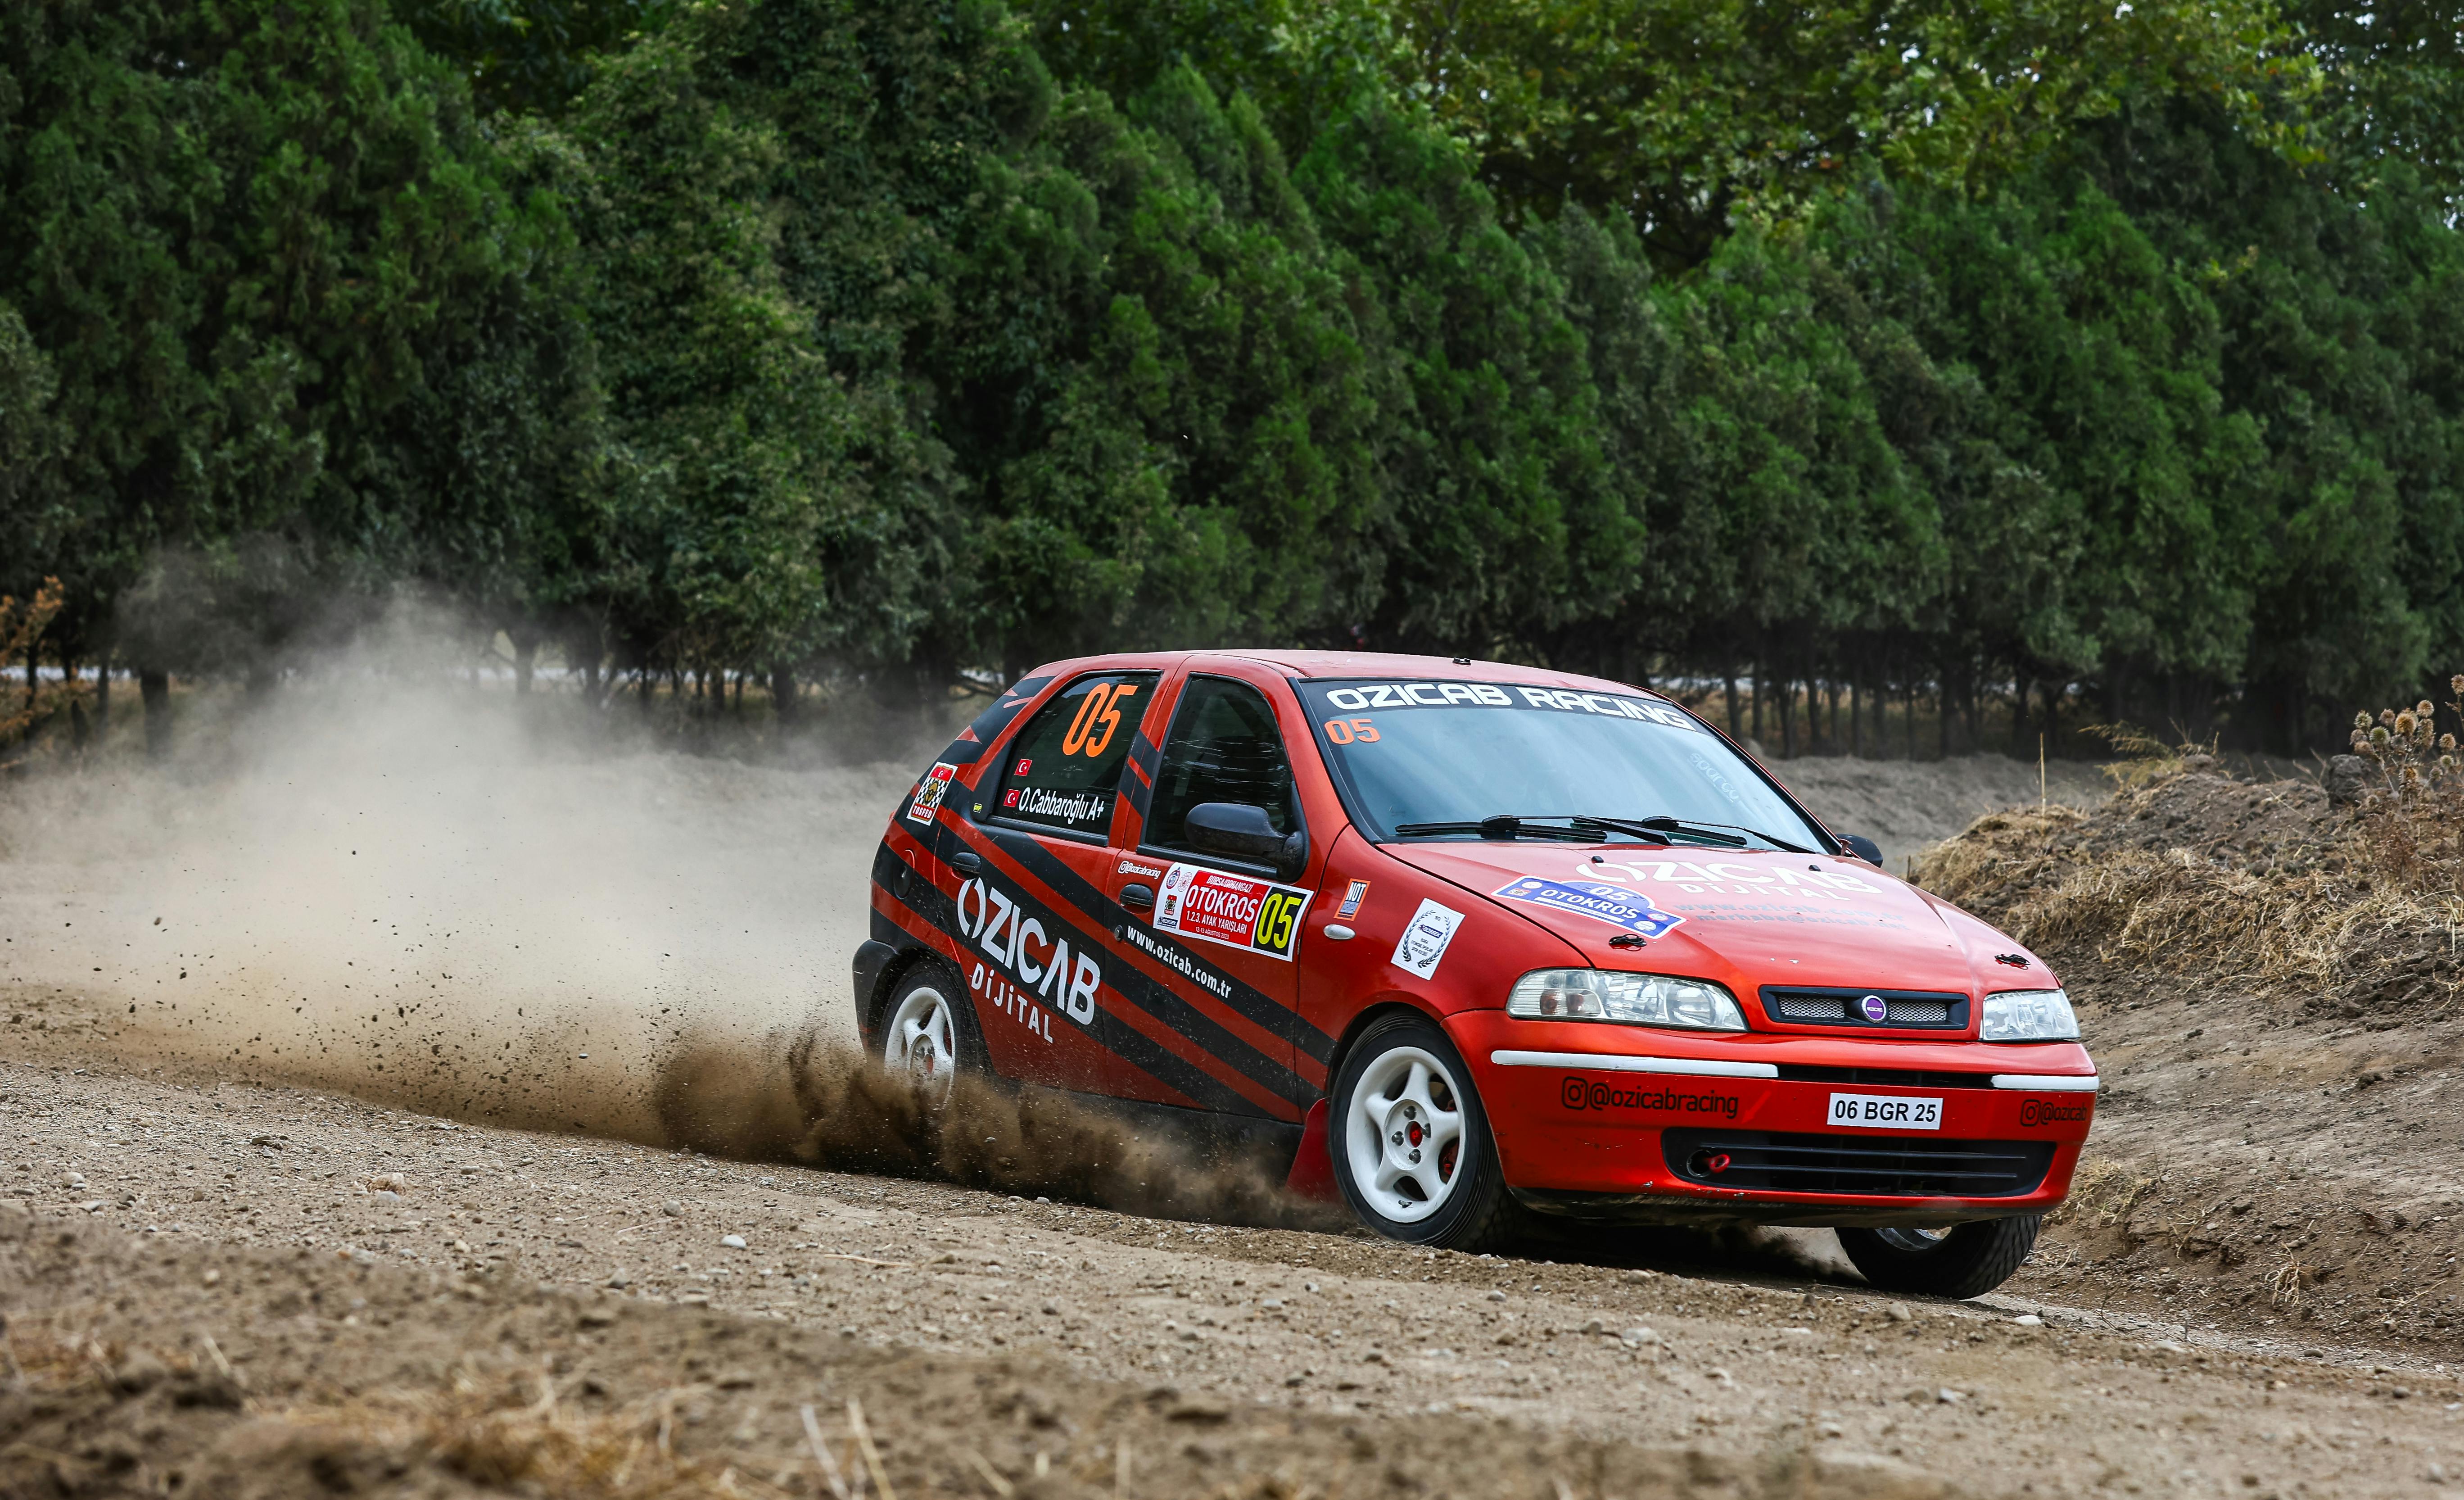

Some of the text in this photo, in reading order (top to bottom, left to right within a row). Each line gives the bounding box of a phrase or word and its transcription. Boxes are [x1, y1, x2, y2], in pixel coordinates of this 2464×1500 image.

[1062, 683, 1138, 757] 05
[1326, 684, 1697, 731] OZICAB RACING
[1325, 719, 1381, 745] 05
[913, 805, 932, 819] TOSFED
[1019, 787, 1104, 825] O.Cabbaroğlu A+
[1126, 863, 1162, 879] @ozicabracing
[1576, 860, 1883, 895] OZICAB
[1185, 885, 1259, 922] OTOKROS
[1345, 882, 1367, 902] NOT
[1540, 889, 1642, 919] OTOKROS
[1589, 886, 1635, 901] 05
[1186, 910, 1201, 923] 1.2.3.
[1201, 914, 1217, 927] AYAK
[1218, 917, 1247, 934] YARIŞLARI
[1257, 893, 1302, 949] 05
[958, 877, 1100, 1025] OZICAB
[1127, 925, 1232, 999] www.ozicab.com.tr
[1590, 1082, 1738, 1119] @ozicabracing
[1835, 1100, 1936, 1123] 06 BGR 25
